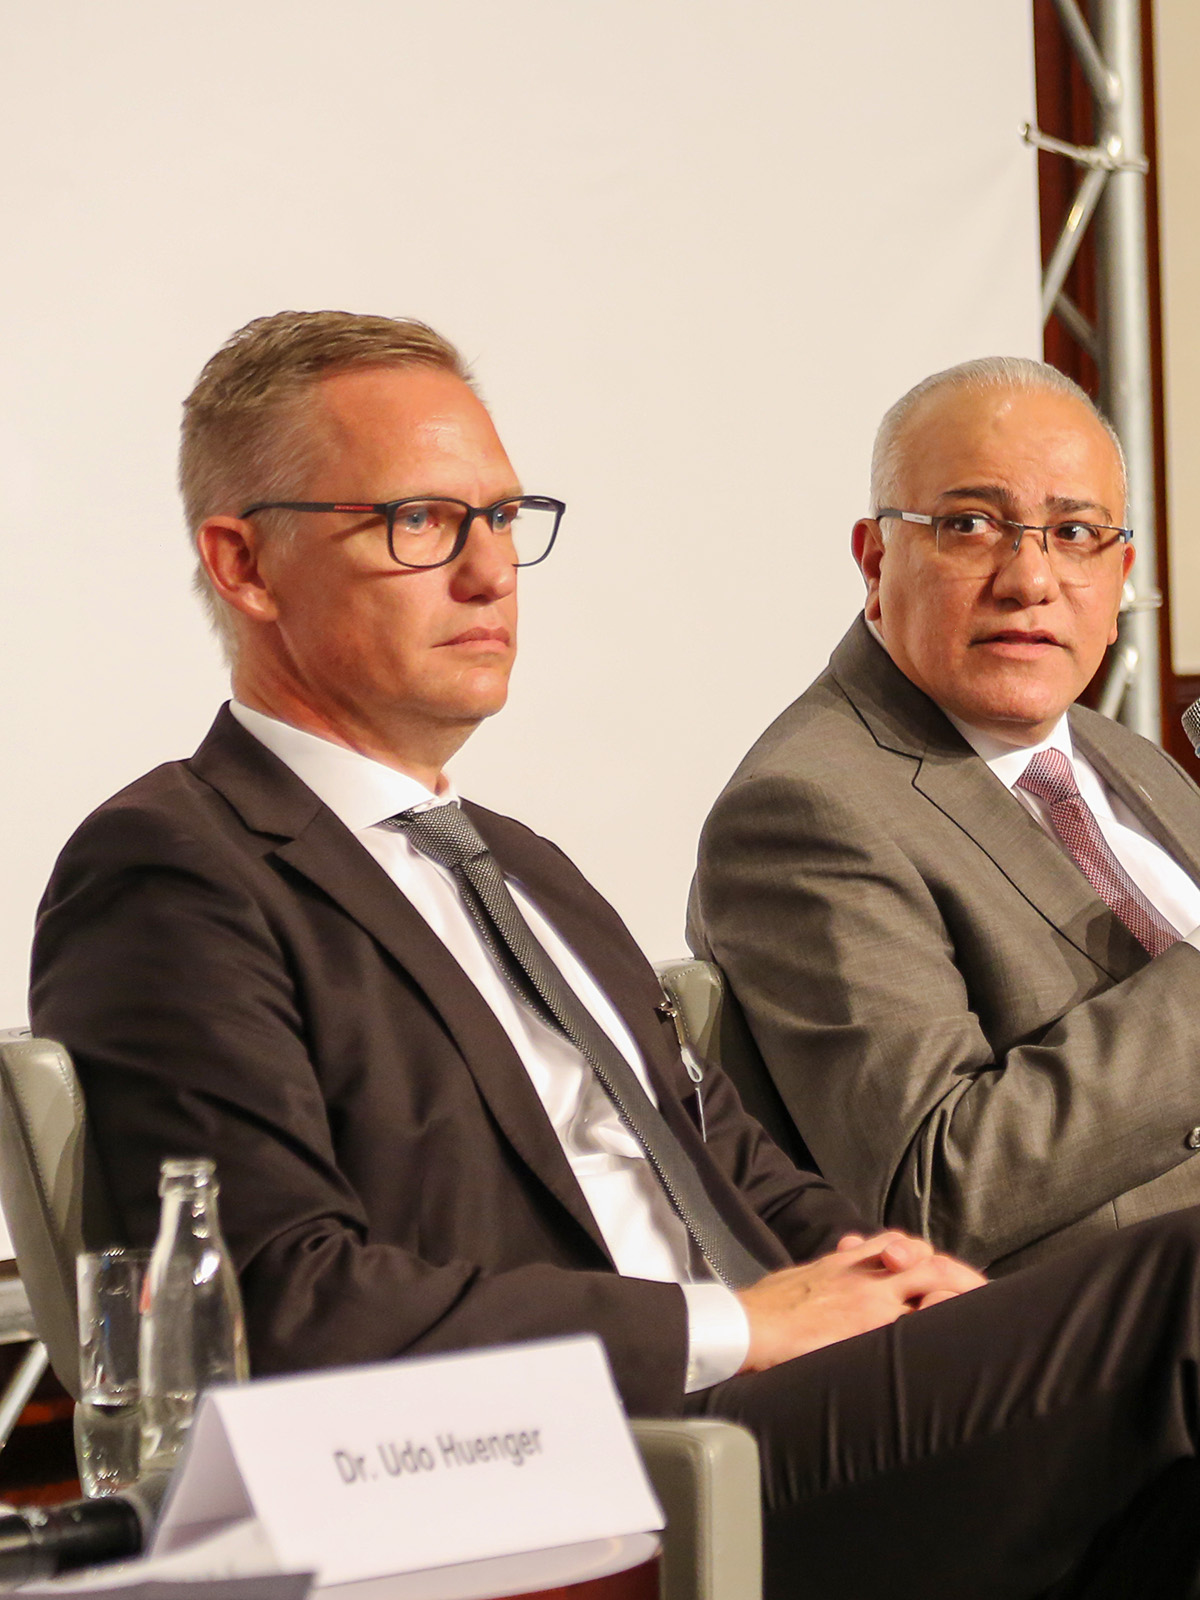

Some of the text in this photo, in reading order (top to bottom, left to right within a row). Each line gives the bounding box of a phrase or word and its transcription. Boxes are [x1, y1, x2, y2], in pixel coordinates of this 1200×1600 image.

[333, 1428, 543, 1484] Dr. Udo Huenger
